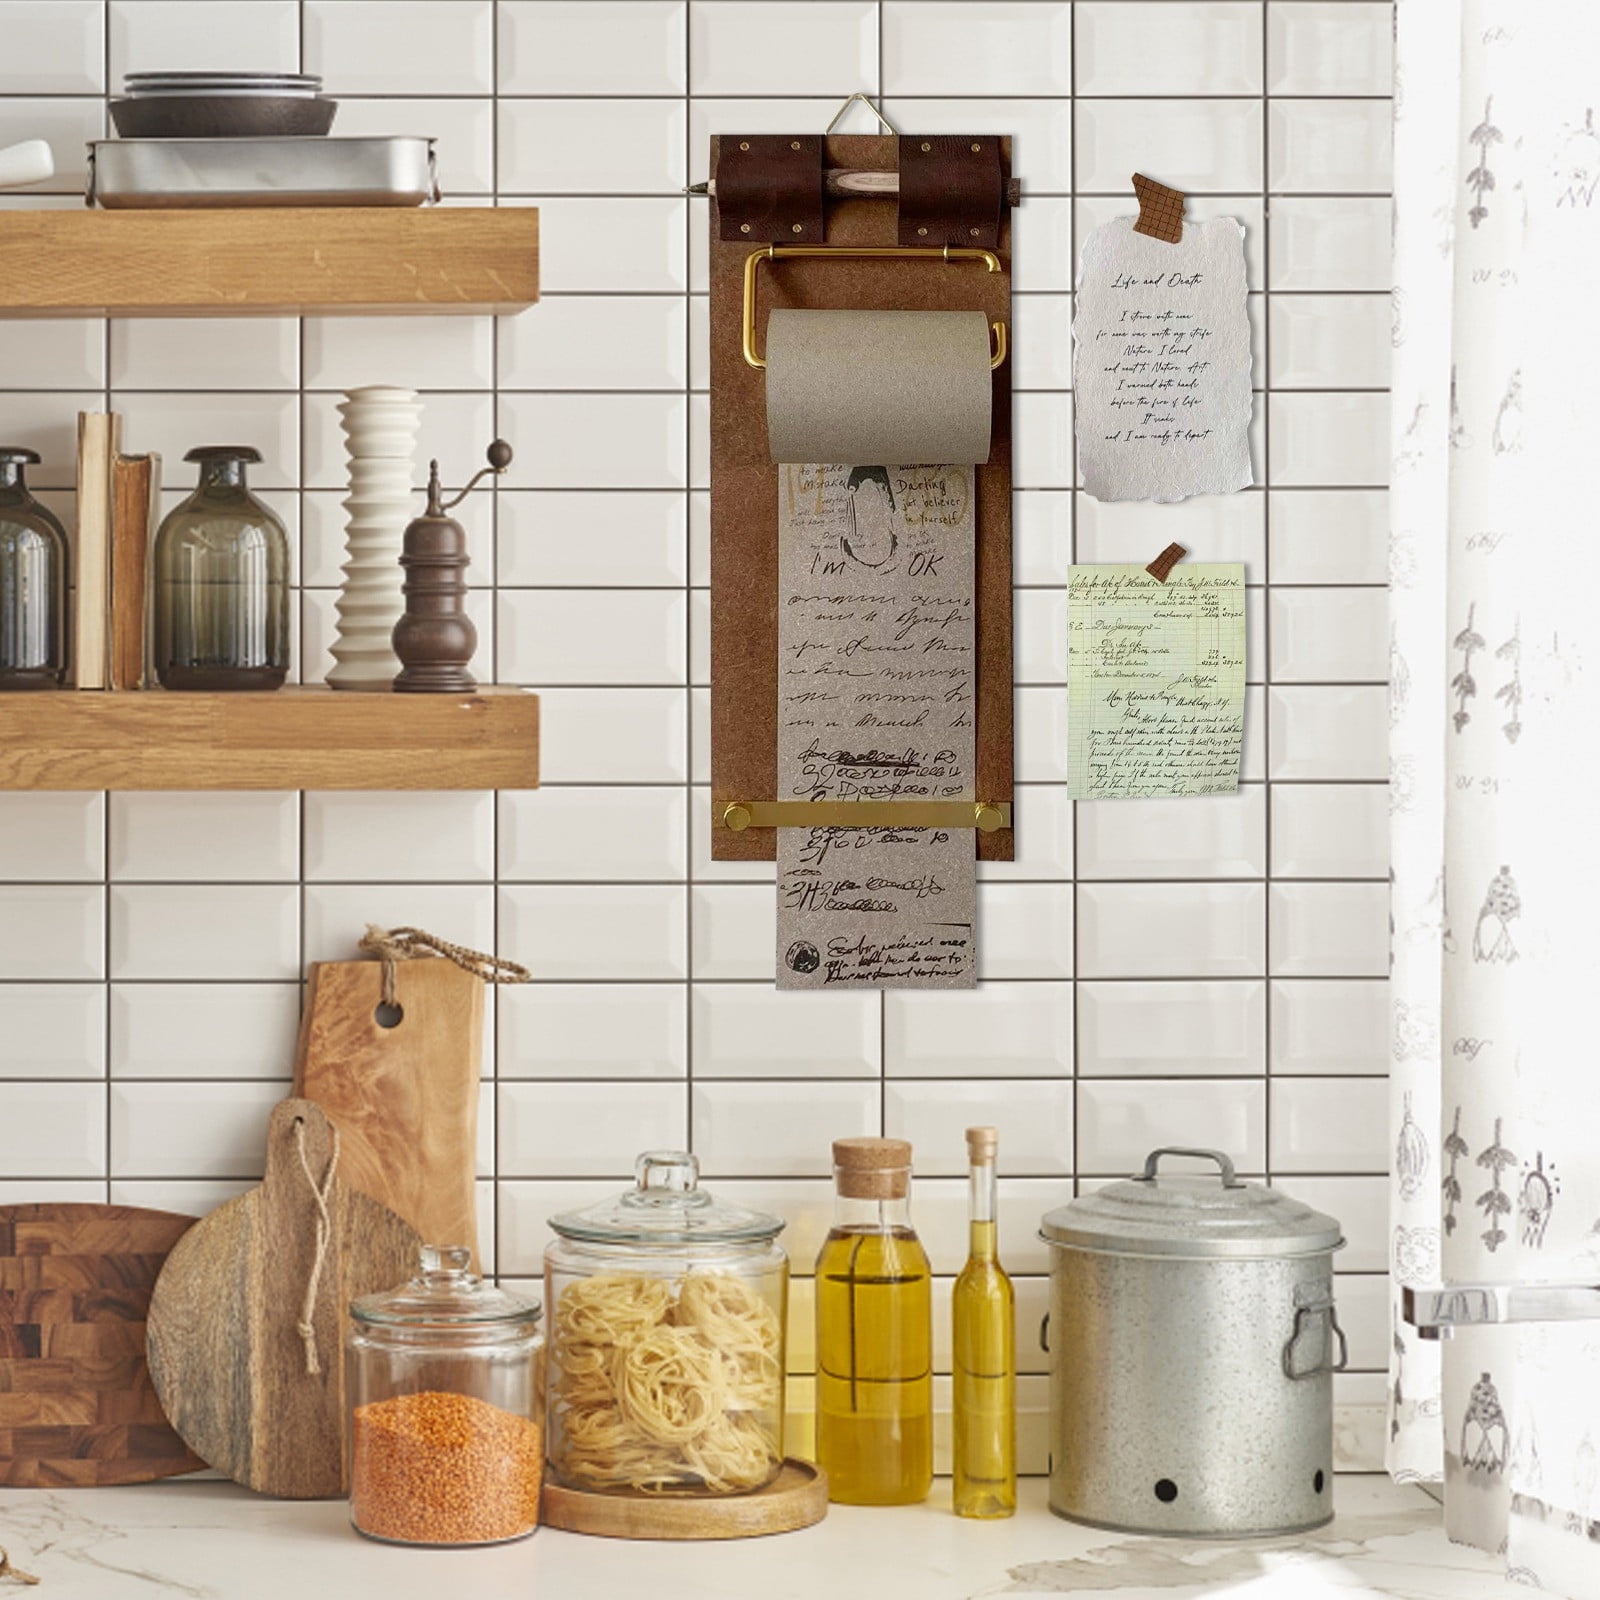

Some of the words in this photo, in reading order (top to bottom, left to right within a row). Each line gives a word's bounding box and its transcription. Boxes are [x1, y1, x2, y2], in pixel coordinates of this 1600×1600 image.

[1110, 273, 1138, 290] Life
[1143, 273, 1165, 288] and
[1167, 272, 1203, 289] Death
[1119, 310, 1129, 322] I
[1156, 310, 1174, 322] with
[1095, 329, 1107, 341] for
[1168, 344, 1192, 356] loved
[1104, 362, 1121, 373] and
[1177, 378, 1199, 390] hands
[1136, 396, 1149, 409] the
[1151, 397, 1169, 409] fire
[1105, 430, 1121, 442] and
[1150, 429, 1171, 446] ready
[1184, 429, 1213, 443] depart
[896, 476, 947, 497] Darling
[810, 552, 846, 576] I'm
[908, 552, 944, 577] OK
